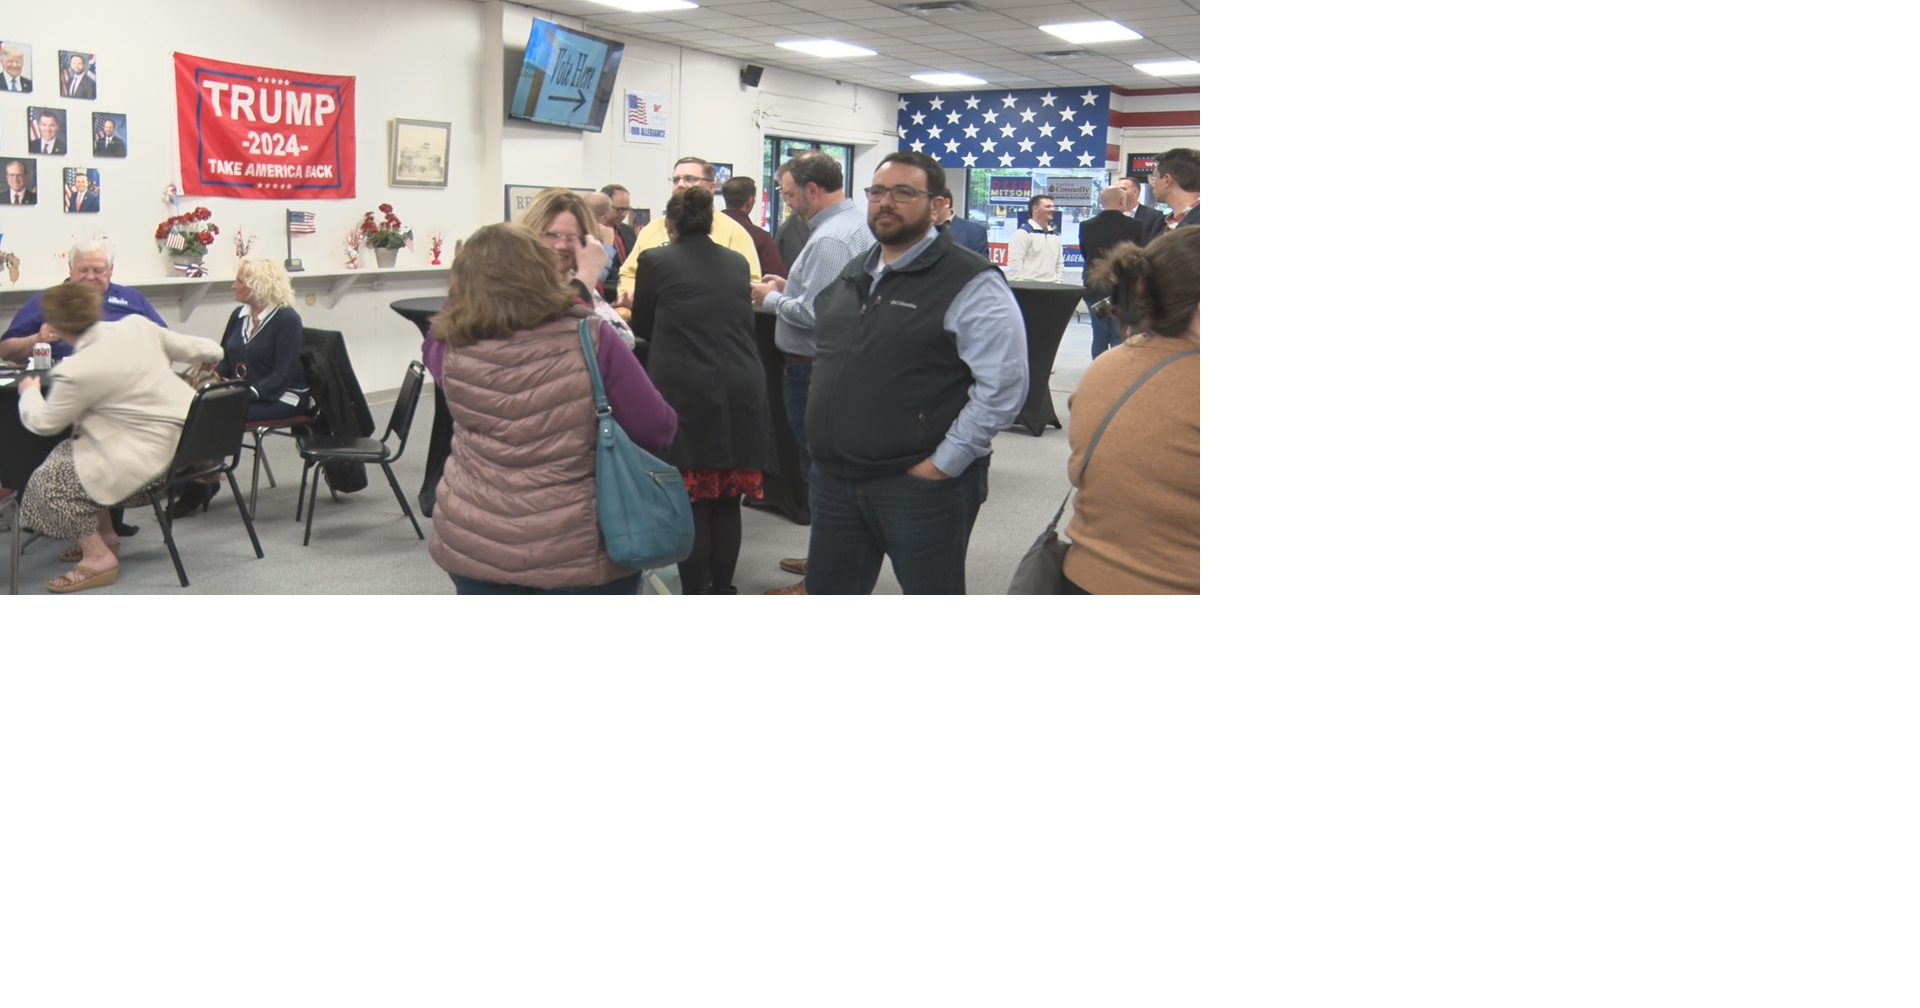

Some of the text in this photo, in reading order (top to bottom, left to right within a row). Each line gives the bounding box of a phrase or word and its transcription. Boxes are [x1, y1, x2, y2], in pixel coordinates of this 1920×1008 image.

[552, 48, 596, 89] Vote Here
[203, 80, 336, 126] TRUMP
[631, 126, 666, 138] OUR ALLEGIANCE
[208, 159, 333, 178] TAKE AMERICA BACK
[991, 180, 1031, 189] OZZIE
[1055, 186, 1090, 195] Connolly
[990, 189, 1031, 197] MITSON
